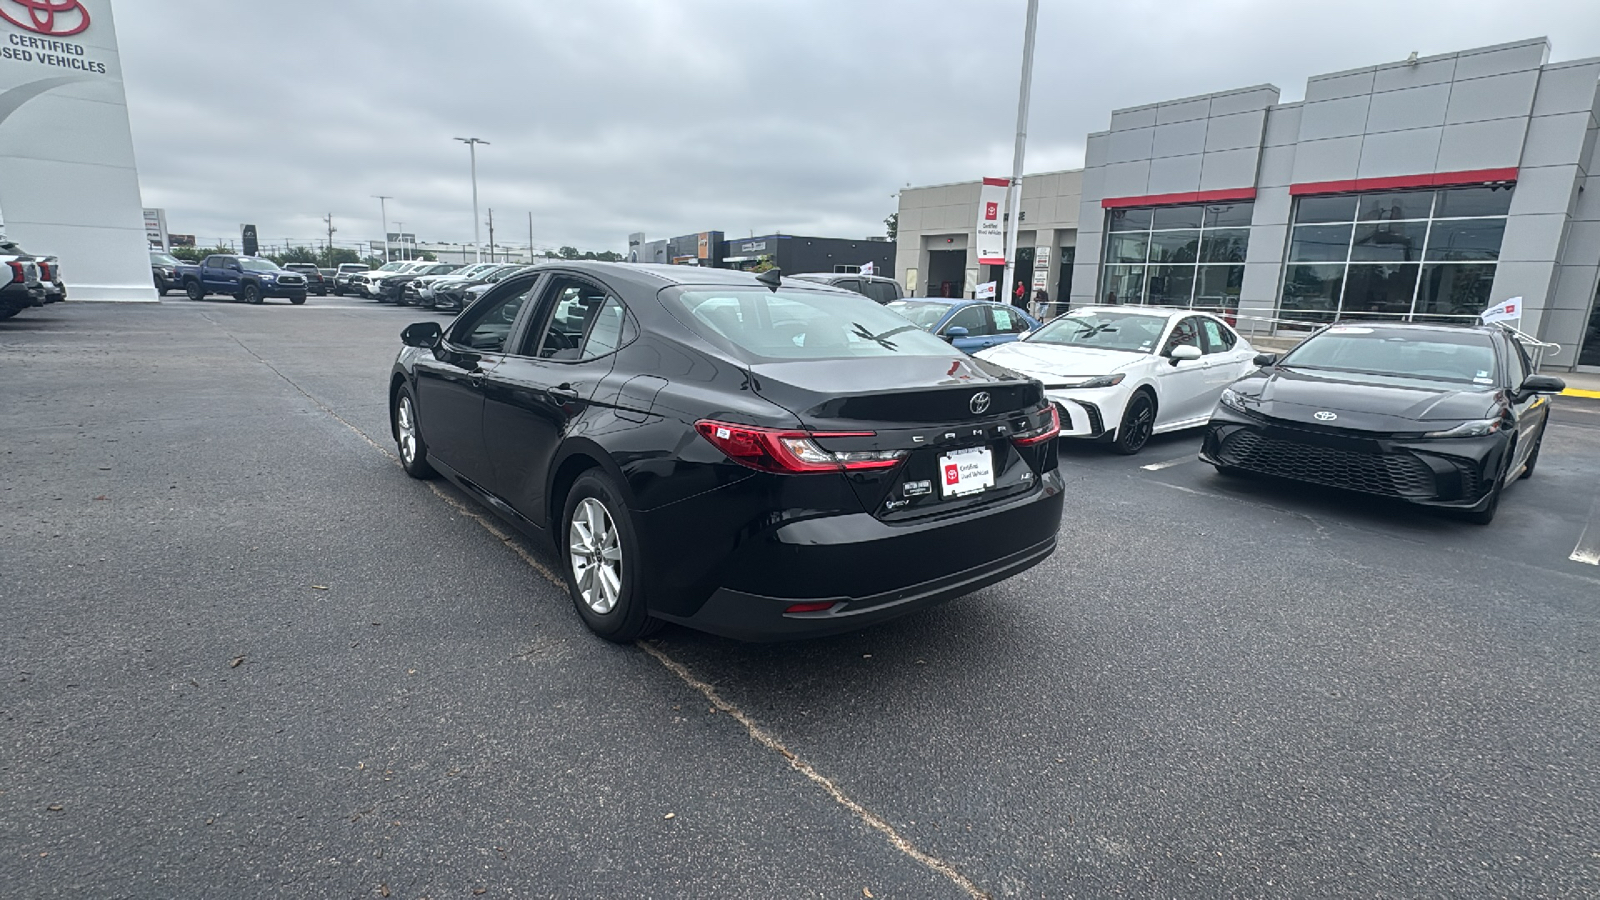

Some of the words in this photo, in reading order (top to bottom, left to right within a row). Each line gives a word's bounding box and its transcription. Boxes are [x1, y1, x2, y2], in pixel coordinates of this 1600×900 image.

[9, 33, 84, 56] CERTIFIED
[36, 51, 106, 74] VEHICLES
[912, 421, 1026, 442] CAMRY
